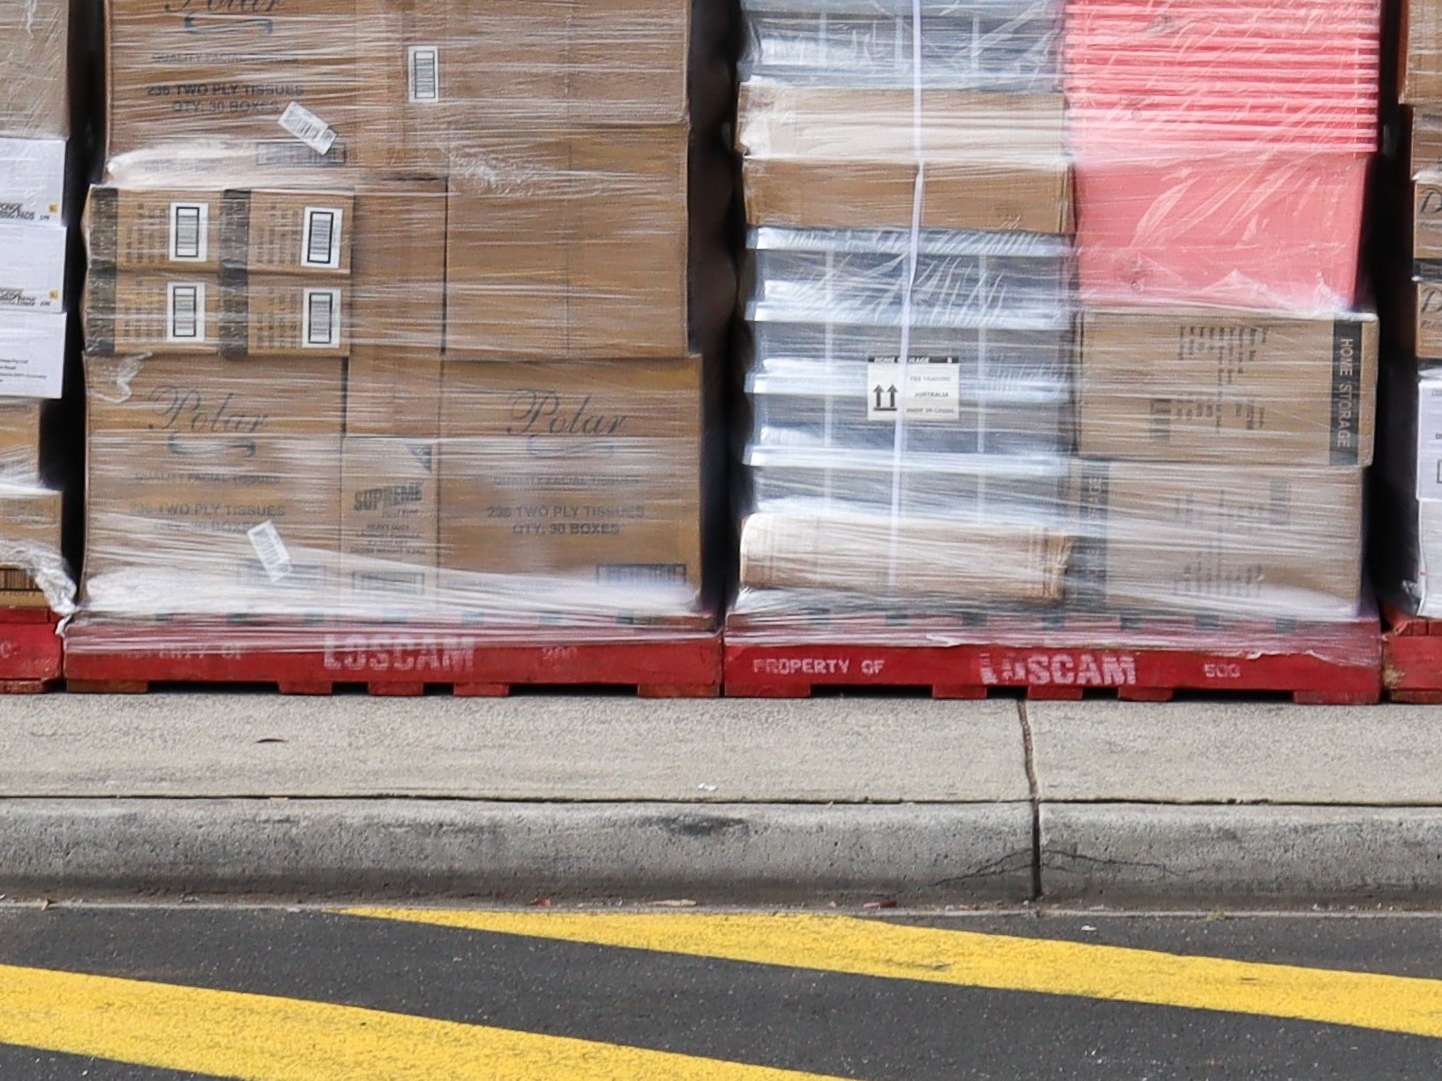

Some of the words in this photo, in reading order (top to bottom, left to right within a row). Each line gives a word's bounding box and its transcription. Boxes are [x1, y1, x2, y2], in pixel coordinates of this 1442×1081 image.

[176, 85, 208, 95] TWO
[212, 85, 238, 95] PLY
[1338, 338, 1354, 376] HOME
[149, 385, 269, 431] Polar
[506, 388, 629, 435] Polar
[1337, 383, 1353, 448] STORAGE
[225, 505, 286, 516] TISSUES
[553, 506, 579, 517] PLY
[569, 524, 619, 534] BOXES
[323, 635, 476, 672] LOSCAM
[753, 658, 850, 677] PROPERTY
[979, 654, 1137, 686] LOSCAM
[1204, 663, 1240, 678] 500
